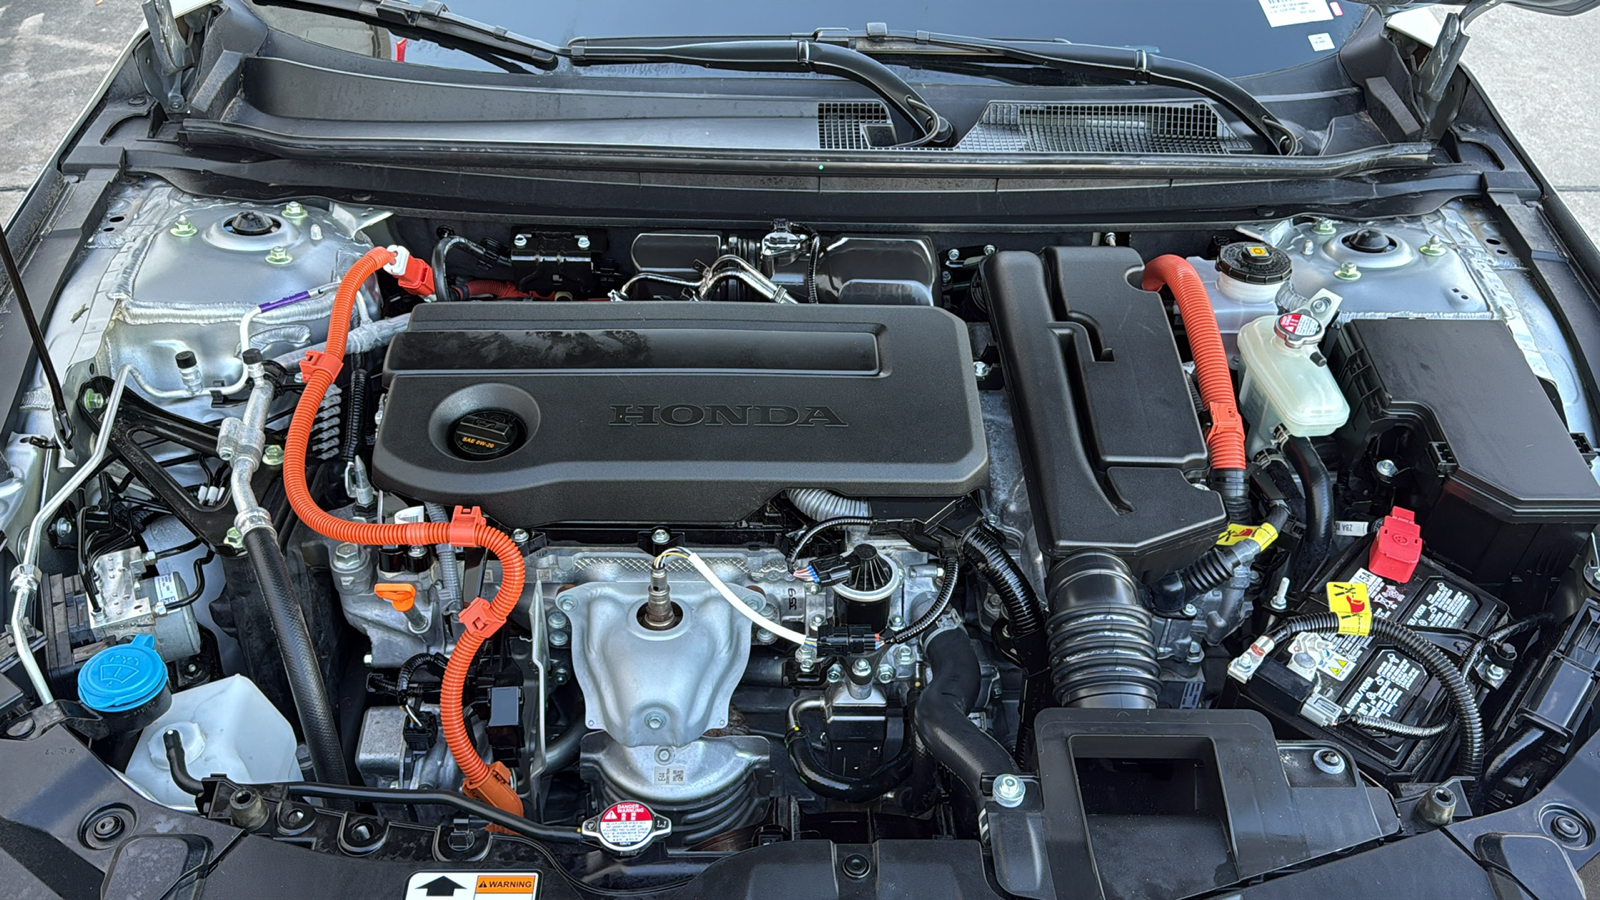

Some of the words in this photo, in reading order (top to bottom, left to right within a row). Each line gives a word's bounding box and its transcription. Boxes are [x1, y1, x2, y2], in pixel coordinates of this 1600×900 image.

[608, 404, 848, 427] HONDA
[475, 440, 494, 448] 0W-20
[489, 880, 532, 888] WARNING
